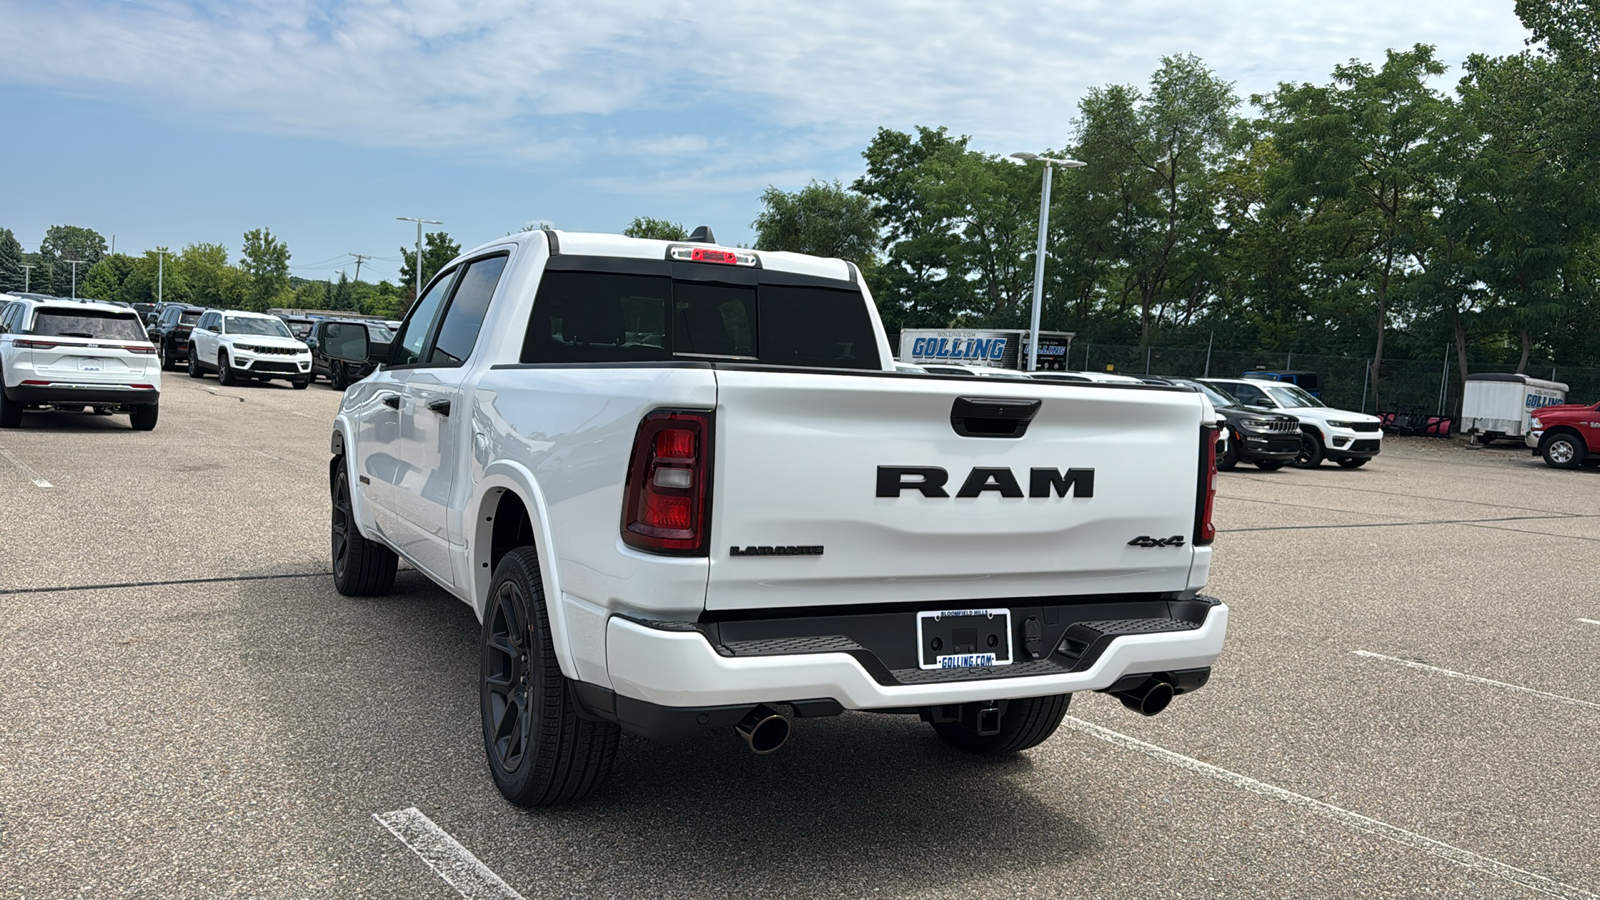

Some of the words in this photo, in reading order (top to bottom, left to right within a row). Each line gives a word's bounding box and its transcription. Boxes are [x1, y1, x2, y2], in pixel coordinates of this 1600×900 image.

[912, 337, 1007, 361] GOLLING
[1024, 344, 1066, 355] GLLING
[876, 465, 1095, 498] RAM
[1127, 535, 1186, 547] 4x4
[729, 545, 824, 556] LARAMIE
[941, 654, 992, 669] GOLLING.COM
